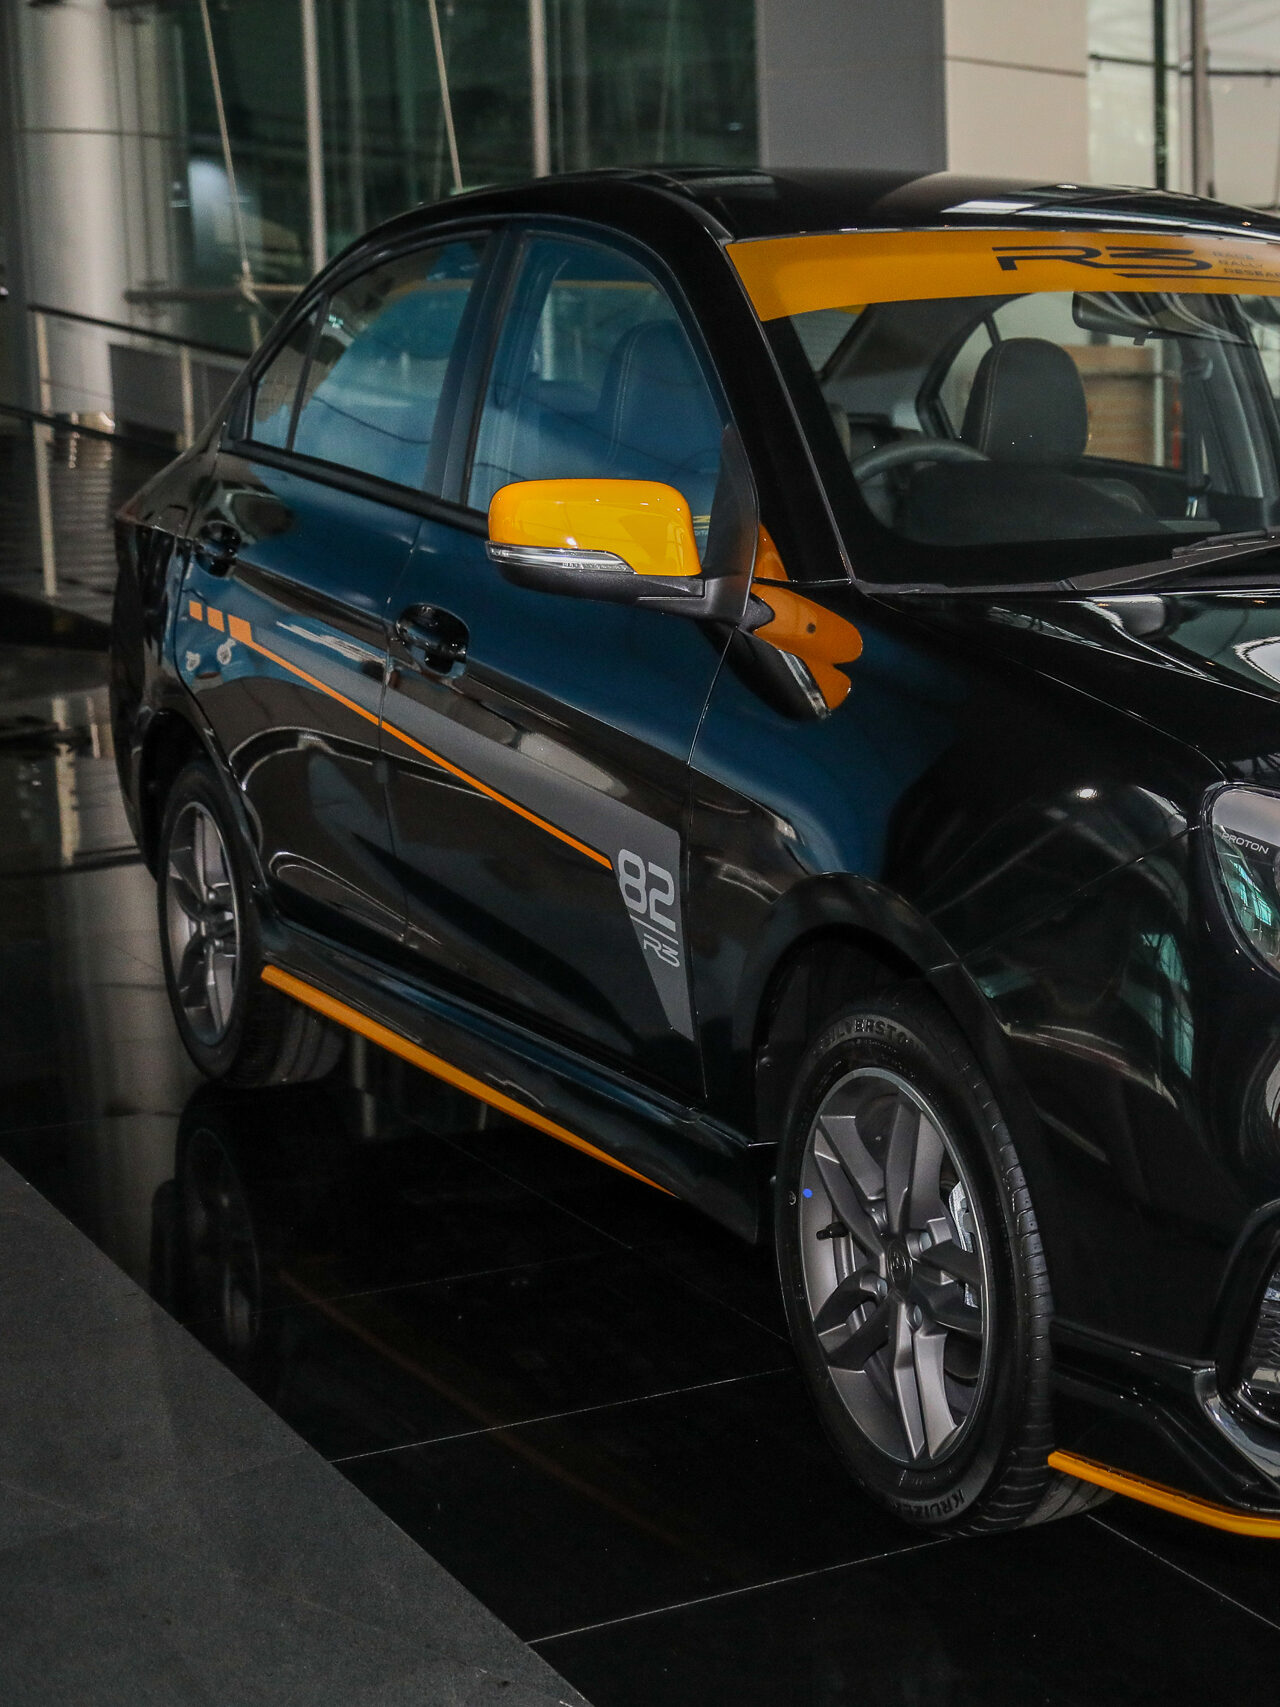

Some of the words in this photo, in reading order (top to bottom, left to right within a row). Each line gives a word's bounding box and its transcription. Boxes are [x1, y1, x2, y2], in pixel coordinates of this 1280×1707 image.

[991, 246, 1212, 271] R3
[1221, 832, 1270, 855] PROTON
[617, 848, 677, 933] 82
